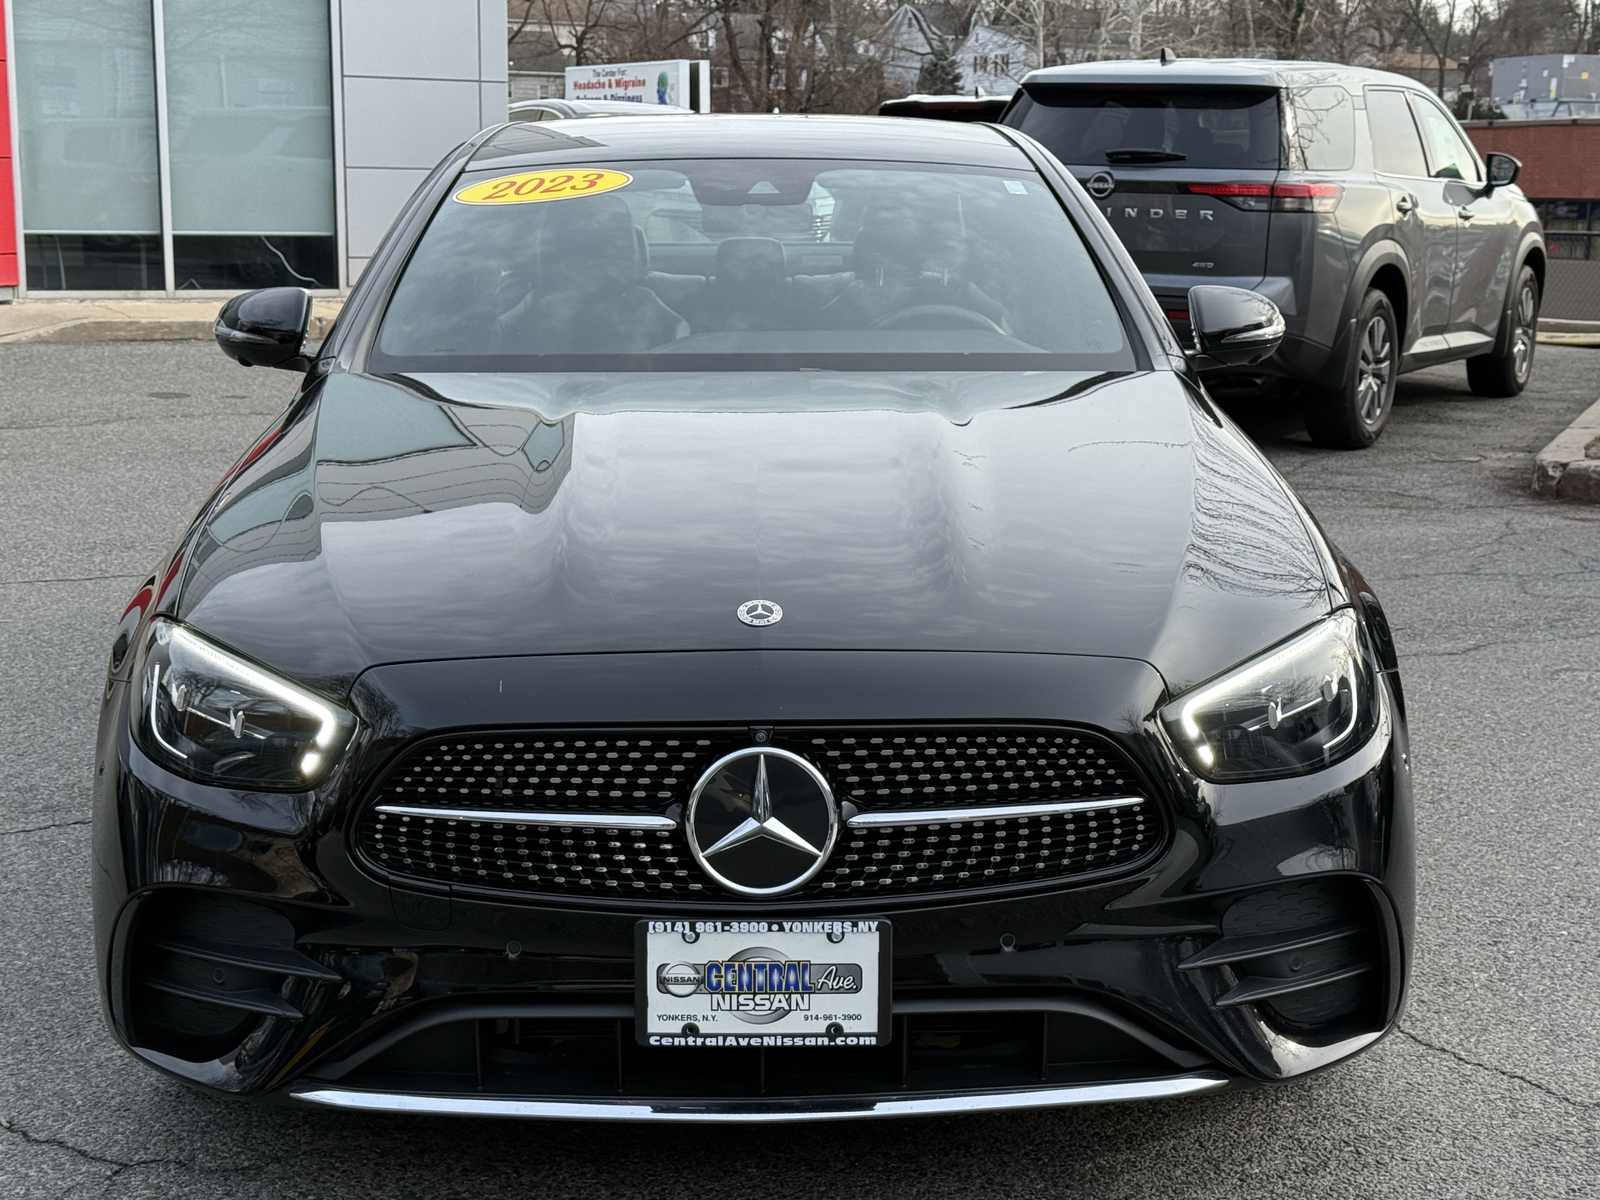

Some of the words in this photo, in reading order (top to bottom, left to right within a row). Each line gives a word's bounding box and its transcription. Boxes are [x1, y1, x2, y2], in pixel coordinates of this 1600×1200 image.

[573, 79, 606, 91] Headache
[608, 79, 613, 89] &
[615, 76, 646, 91] Migraine
[481, 173, 605, 201] 2023
[1192, 261, 1215, 269] 4WD
[695, 921, 768, 933] 961-3900
[705, 961, 815, 993] CENTRAL
[817, 964, 858, 991] Ave.
[711, 993, 810, 1011] NISSAN
[656, 1014, 700, 1023] YONKERS,
[702, 1014, 718, 1022] N.Y.
[649, 1036, 877, 1046] CentralAveNissan.com
